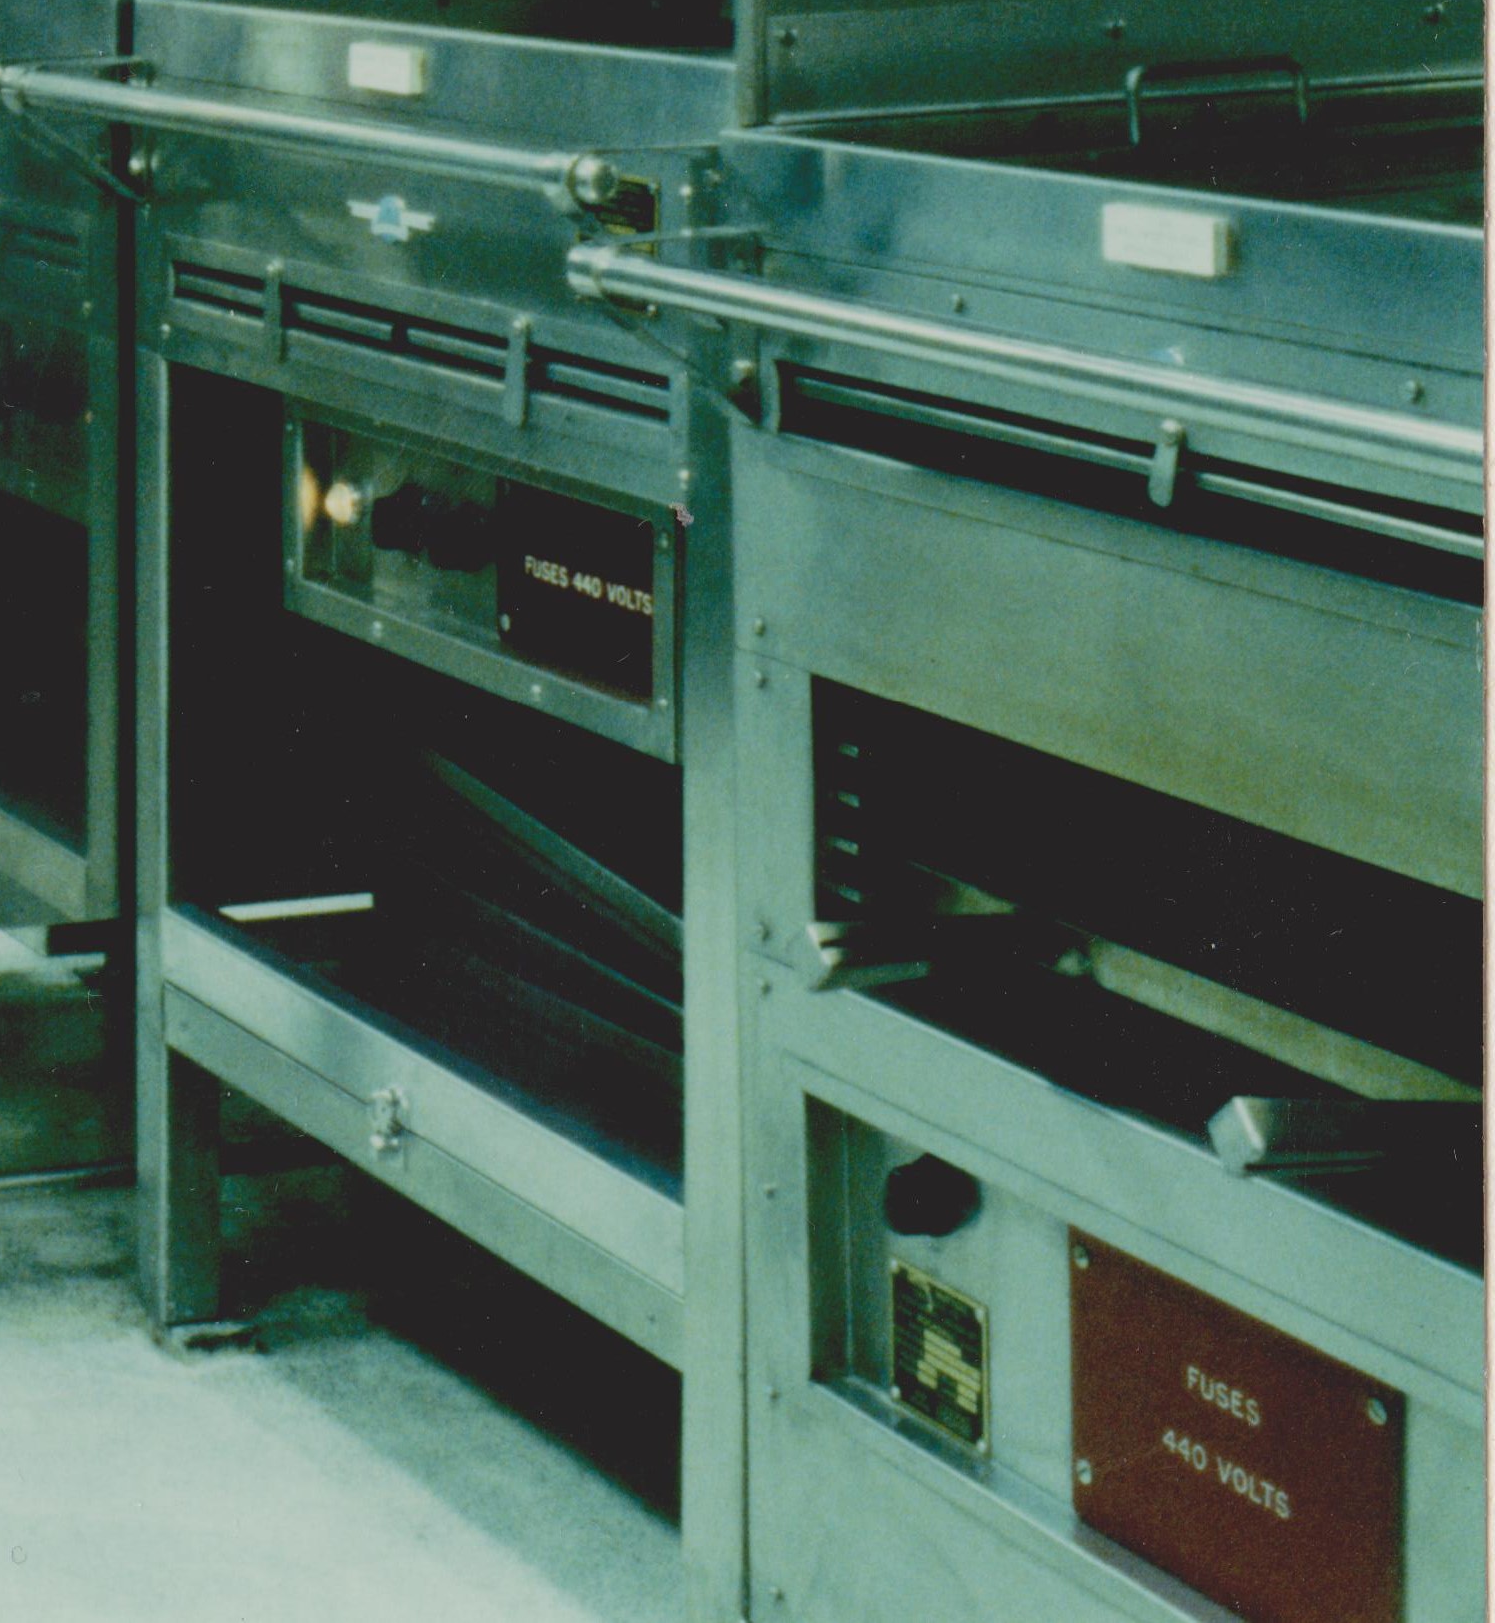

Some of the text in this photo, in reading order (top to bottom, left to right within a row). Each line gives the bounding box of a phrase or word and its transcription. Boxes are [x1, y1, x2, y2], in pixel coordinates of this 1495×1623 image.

[524, 555, 654, 616] FUSES 440 VOLTS
[1187, 1365, 1261, 1427] FUSES
[1162, 1429, 1291, 1519] 440 VOLTS
